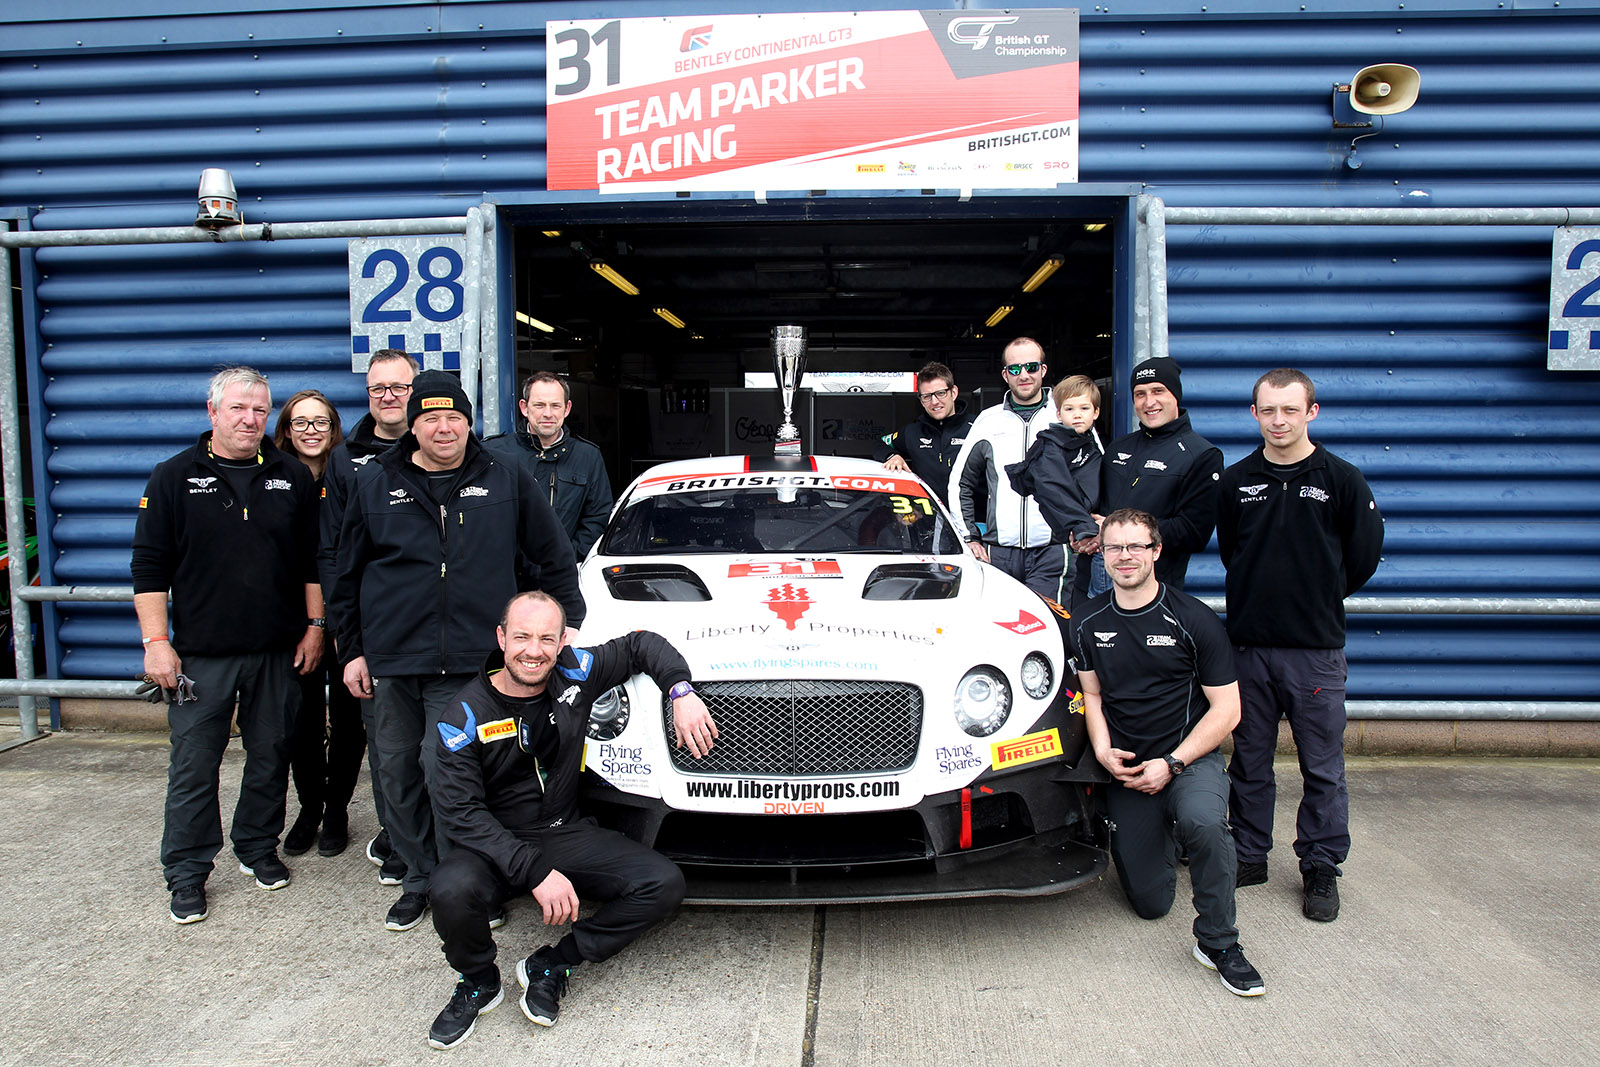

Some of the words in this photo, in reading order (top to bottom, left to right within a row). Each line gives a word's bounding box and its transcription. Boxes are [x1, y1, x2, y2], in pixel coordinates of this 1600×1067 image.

[995, 35, 1031, 45] British
[1034, 35, 1050, 45] GT
[554, 20, 621, 96] 31
[674, 51, 732, 73] BENTLEY
[734, 32, 826, 61] CONTINENTAL
[828, 28, 853, 43] GT3
[995, 46, 1067, 57] Championship
[594, 87, 702, 140] TEAM
[710, 56, 867, 119] PARKER
[968, 126, 1071, 152] BRITISHGT.COM
[597, 124, 737, 184] RACING
[1043, 161, 1070, 170] SRO
[362, 246, 464, 323] 28
[189, 487, 218, 495] BENTLEY
[667, 475, 896, 493] BRITISHGT.COM
[389, 497, 415, 506] BENTLEY
[889, 496, 935, 516] 31
[1240, 495, 1269, 504] BENTLEY
[746, 561, 817, 577] 31
[686, 623, 770, 641] Liberty
[809, 622, 935, 646] Properties
[709, 658, 879, 671] www.flyingspares.com
[600, 743, 643, 763] Flying
[935, 743, 974, 761] Flying
[997, 734, 1055, 764] PIRELLI
[601, 759, 652, 776] Spares
[939, 756, 982, 775] Spares
[686, 780, 900, 802] www.libertyprops.com
[763, 802, 825, 815] DRIVEN
